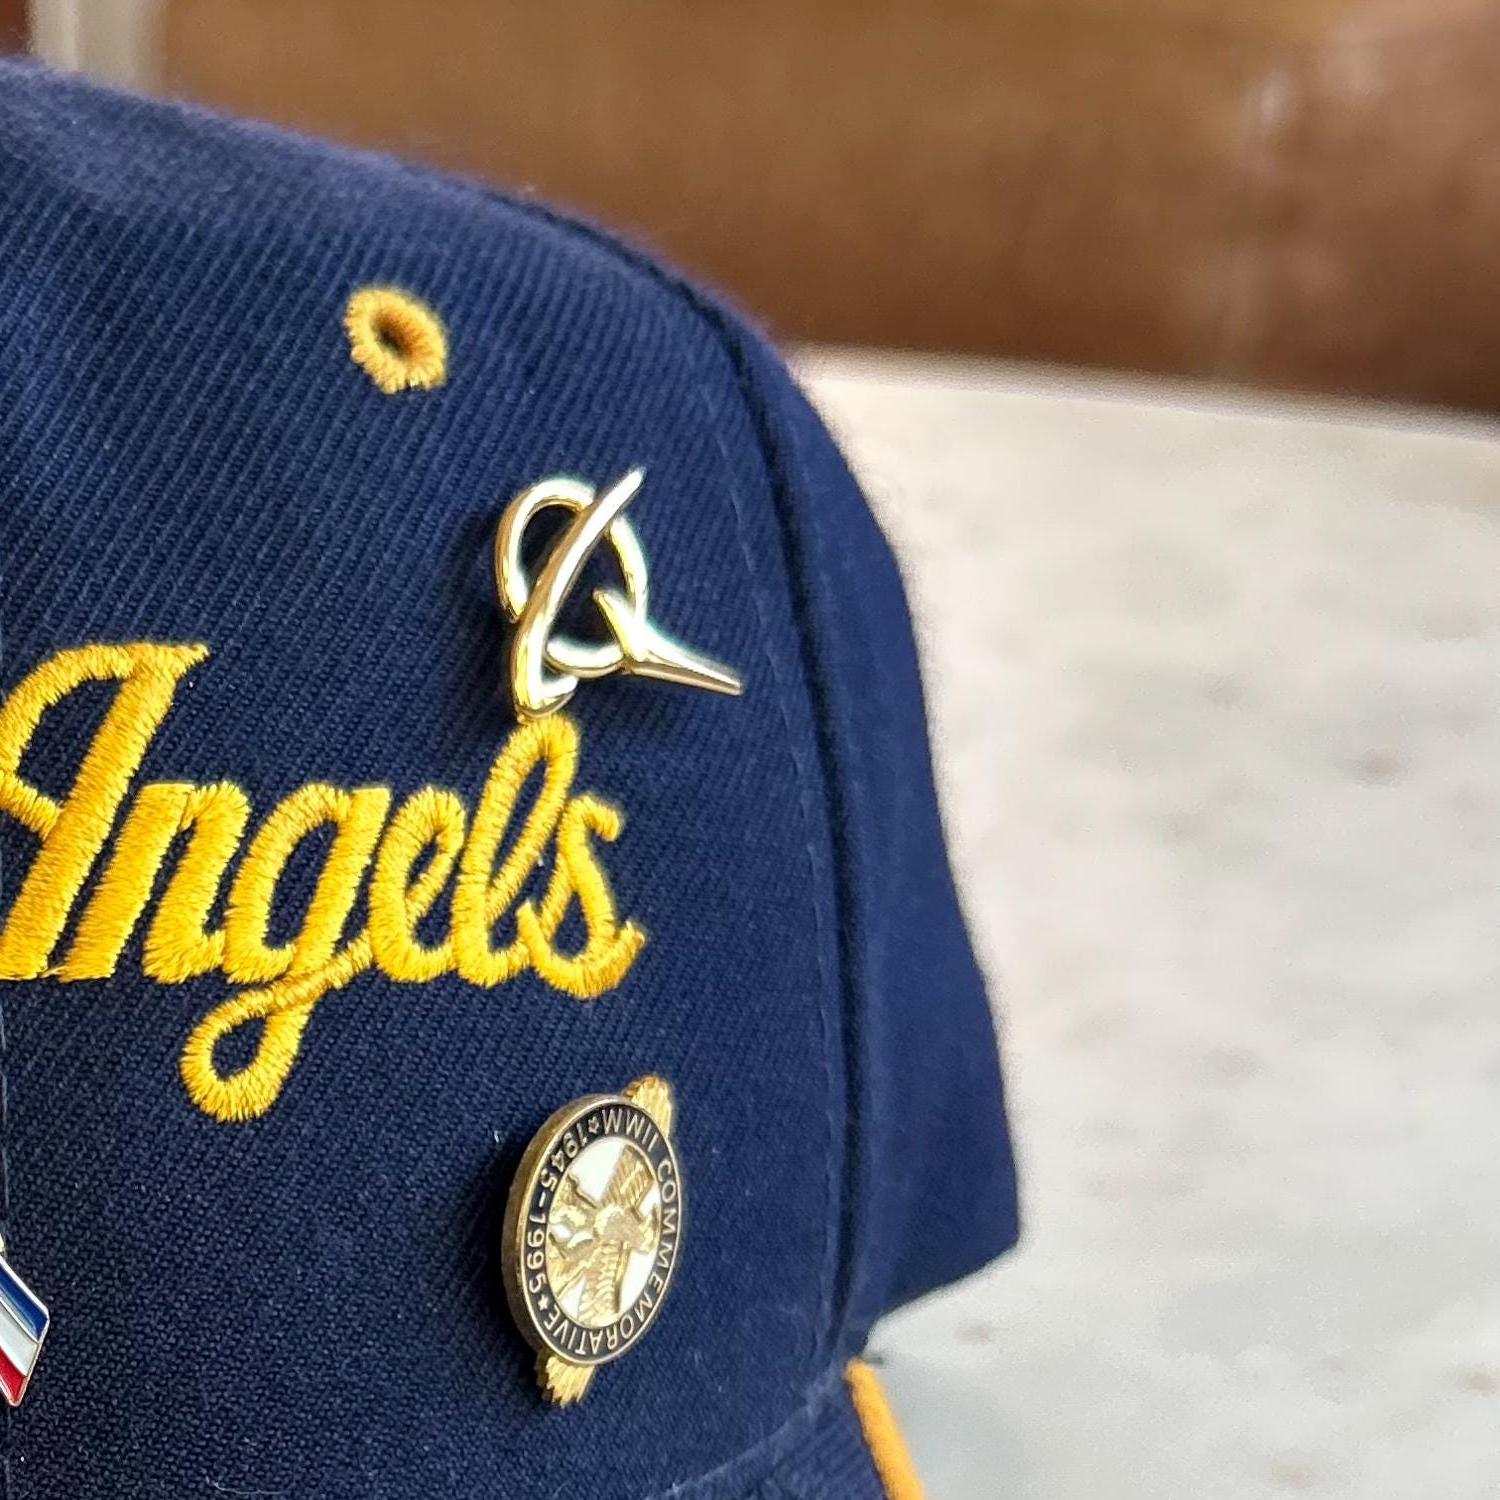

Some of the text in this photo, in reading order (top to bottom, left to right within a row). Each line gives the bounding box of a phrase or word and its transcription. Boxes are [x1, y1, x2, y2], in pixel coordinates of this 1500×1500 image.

[526, 1122, 589, 1294] 1945-1995
[543, 1107, 677, 1356] WWII COMMEMORATIVE
